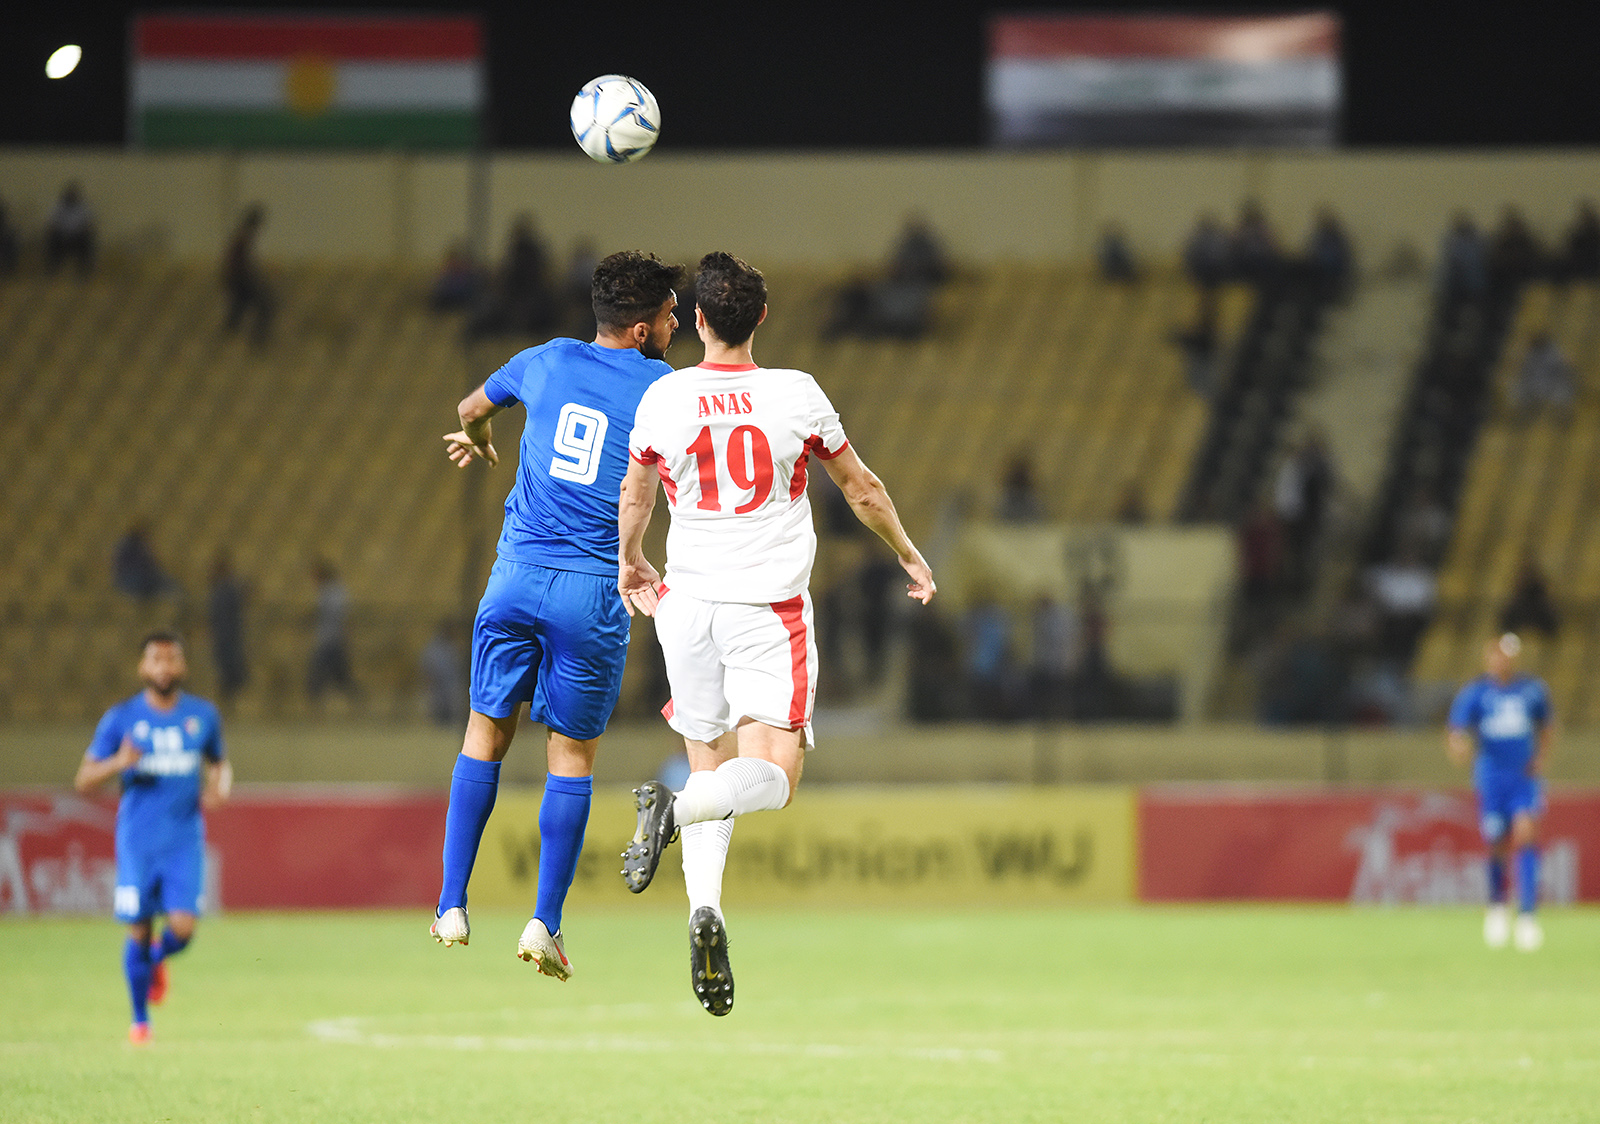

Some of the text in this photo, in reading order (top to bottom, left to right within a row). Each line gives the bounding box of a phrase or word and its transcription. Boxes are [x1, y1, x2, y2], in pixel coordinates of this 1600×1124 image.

[698, 391, 753, 418] ANAS
[549, 402, 609, 486] 9
[686, 424, 774, 515] 19
[975, 826, 1094, 887] WU
